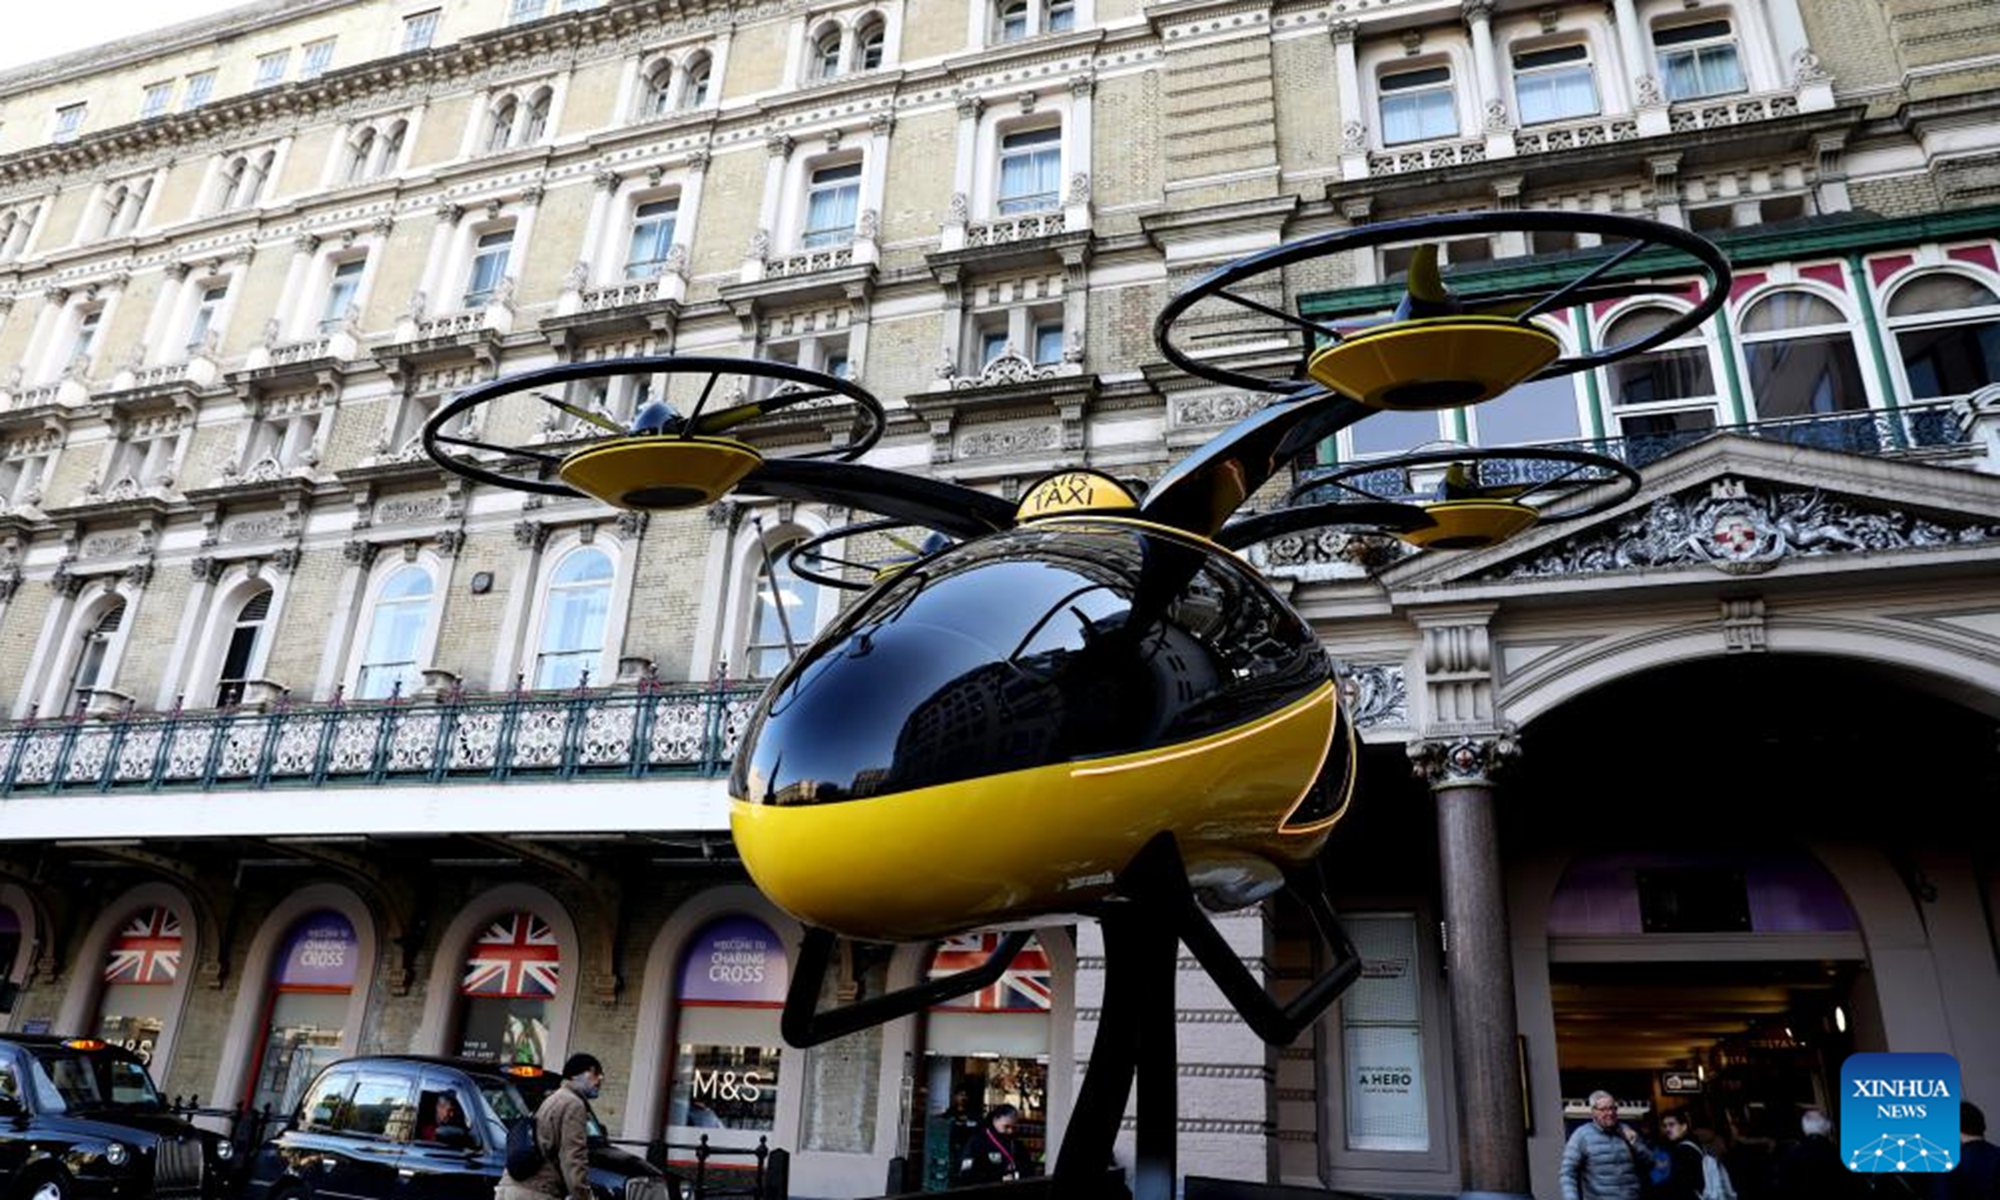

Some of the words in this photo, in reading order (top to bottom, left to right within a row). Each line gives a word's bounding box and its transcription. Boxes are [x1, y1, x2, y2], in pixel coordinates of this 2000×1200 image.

[1033, 486, 1094, 511] TAXI
[711, 952, 766, 964] CHARING
[709, 965, 764, 983] CROSS
[693, 1068, 761, 1102] M&S
[1359, 1075, 1369, 1085] A
[1372, 1074, 1412, 1086] HERO
